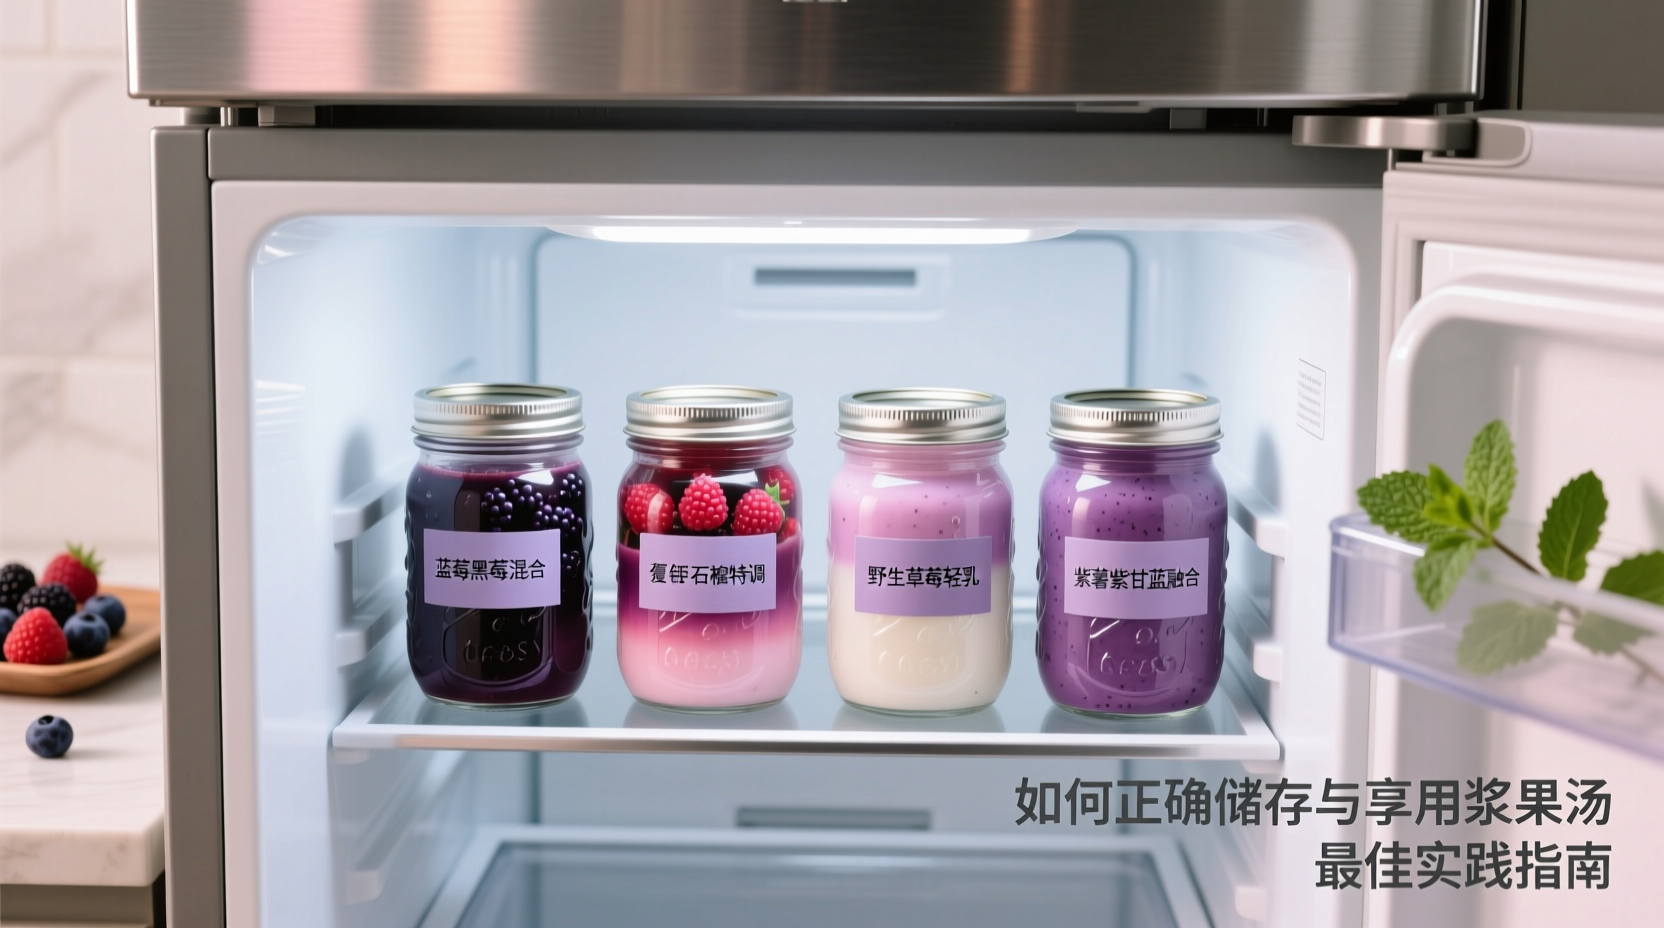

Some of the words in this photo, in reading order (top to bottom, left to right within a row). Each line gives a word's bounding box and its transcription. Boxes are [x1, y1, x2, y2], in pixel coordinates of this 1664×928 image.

[435, 557, 546, 581] 蓝莓黑莓混合
[868, 565, 980, 588] 野生草莓轻乳
[1074, 566, 1200, 590] 紫薯紫甘蓝融合
